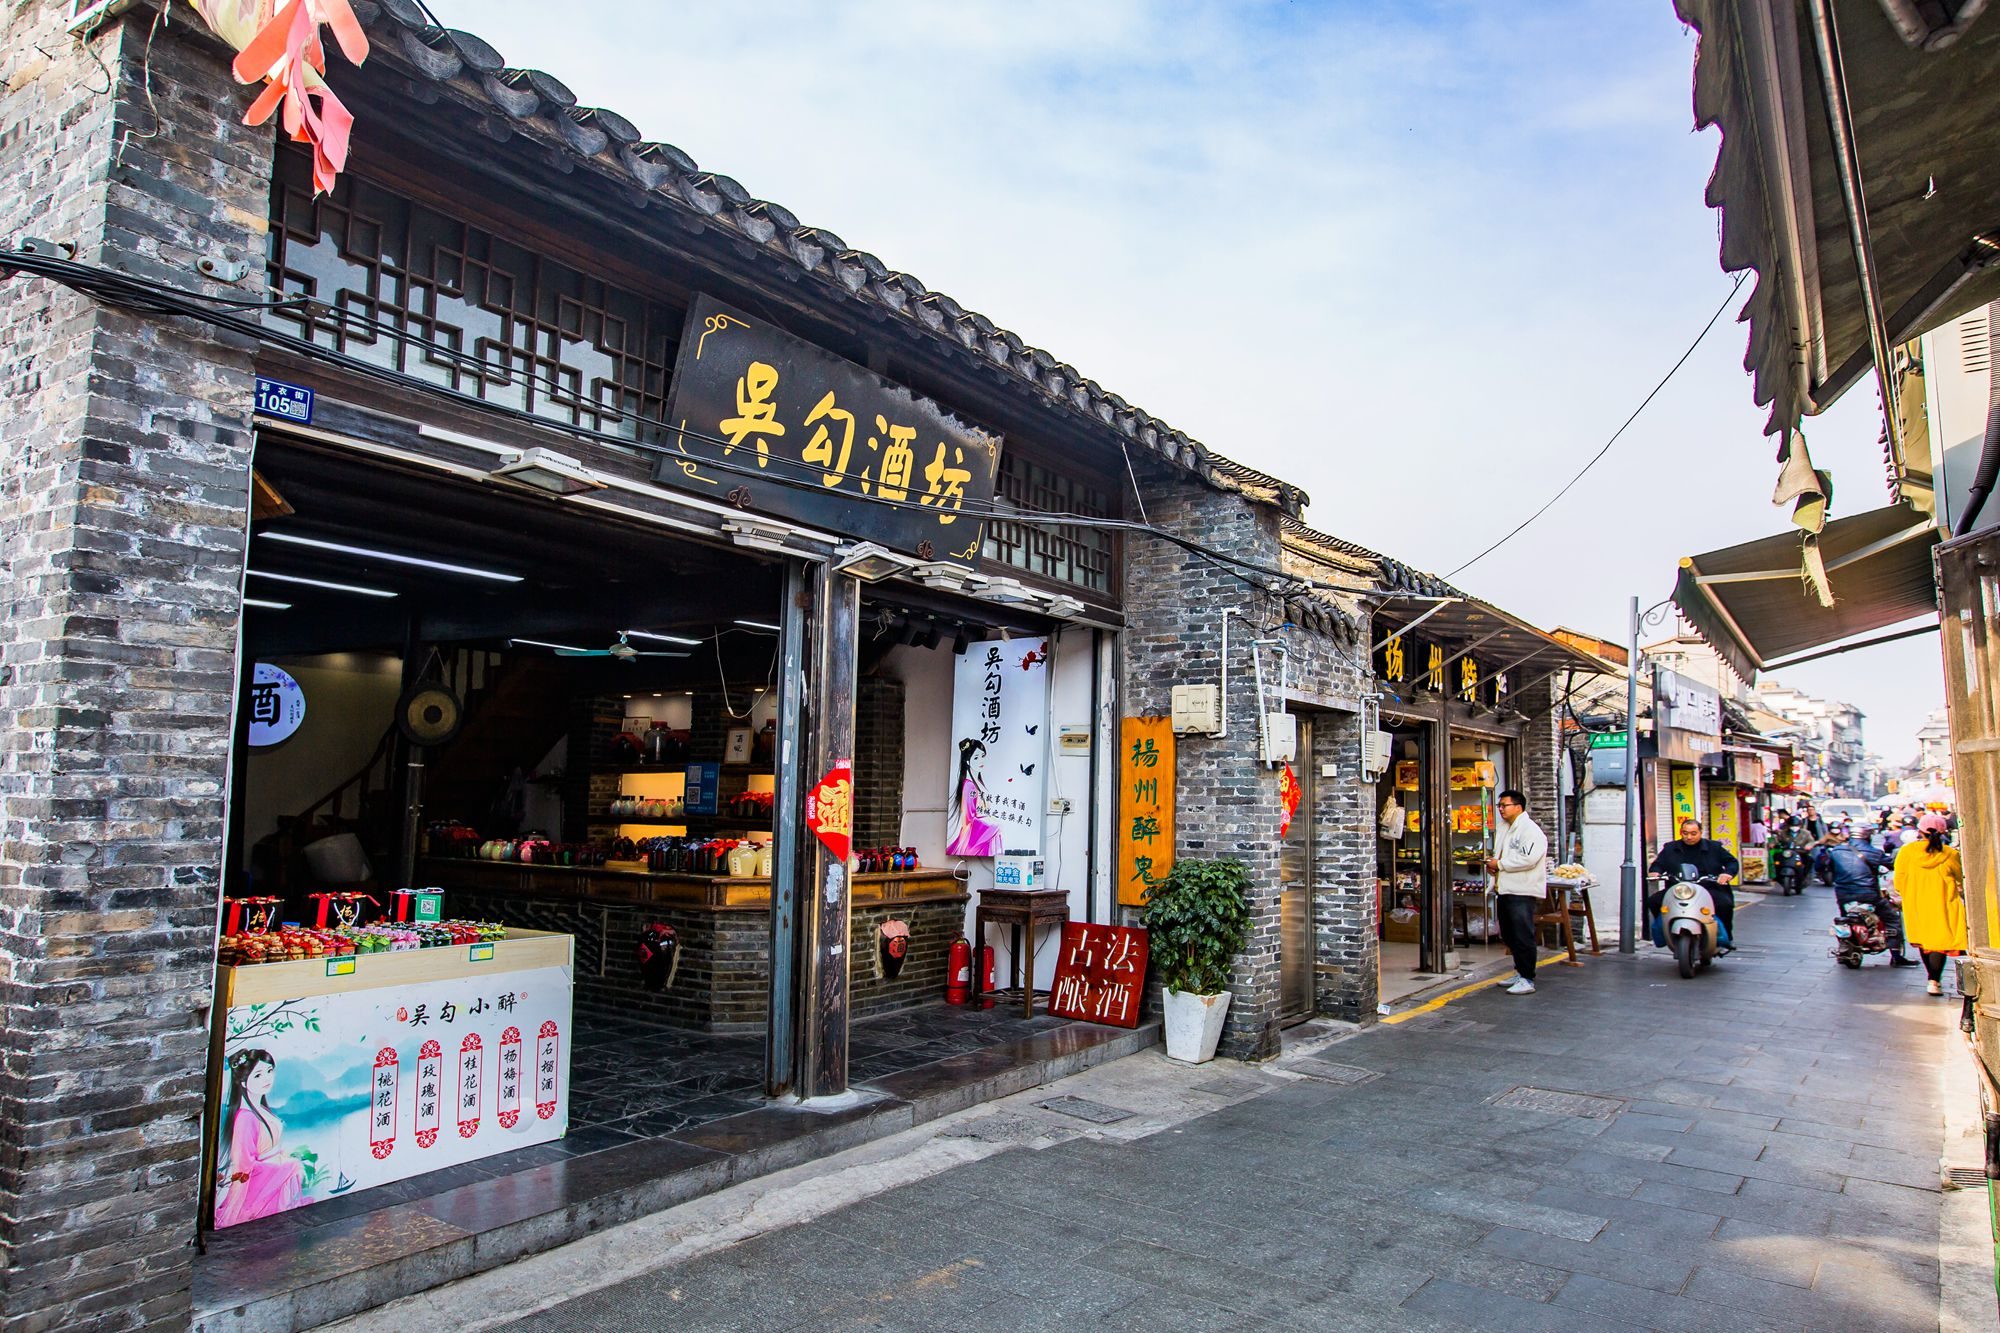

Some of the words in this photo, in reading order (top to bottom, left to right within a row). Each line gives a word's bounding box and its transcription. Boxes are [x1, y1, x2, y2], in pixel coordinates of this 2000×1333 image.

[259, 392, 290, 413] 105
[1068, 929, 1141, 973] 古法
[409, 992, 518, 1027] 吴勾小醉
[1054, 974, 1134, 1020] 酿酒
[421, 1063, 437, 1117] 玫瑰酒
[463, 1055, 478, 1108] 桂花酒
[503, 1049, 518, 1099] 杨梅酒
[541, 1042, 554, 1091] 石榴酒
[376, 1072, 394, 1127] 桃花酒
